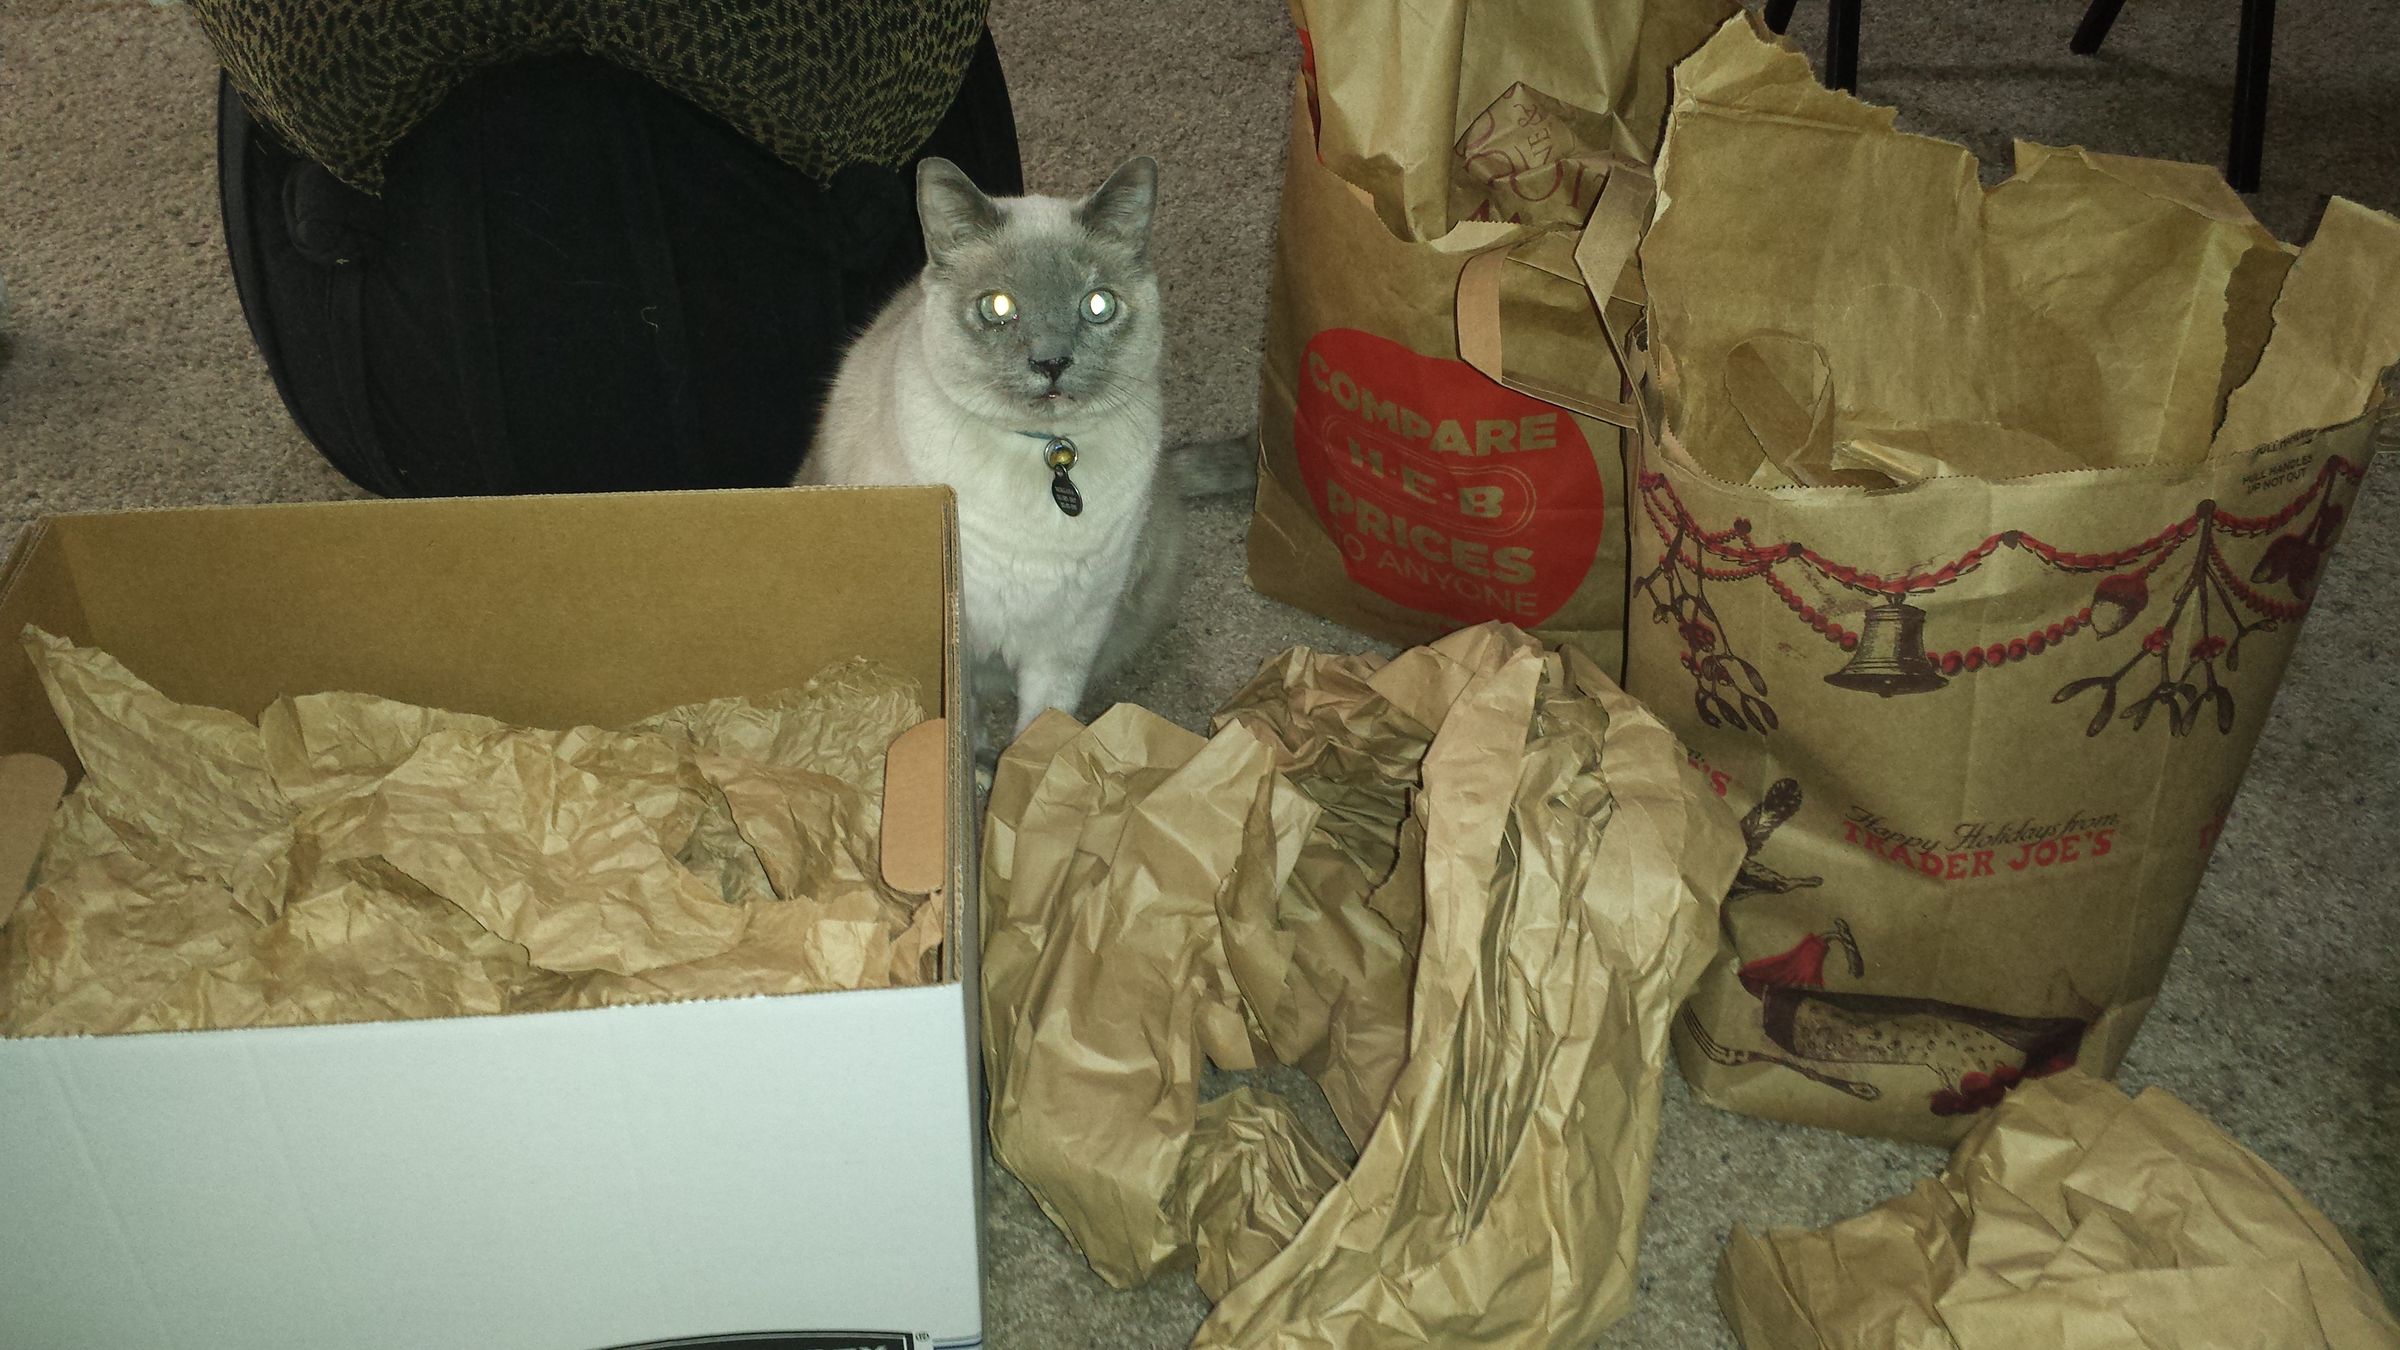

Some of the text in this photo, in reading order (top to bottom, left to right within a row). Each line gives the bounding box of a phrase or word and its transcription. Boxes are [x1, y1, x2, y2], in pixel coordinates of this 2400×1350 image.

[1308, 350, 1558, 458] COMPARE
[2263, 475, 2285, 490] NOT
[2286, 467, 2307, 483] OUT
[2269, 454, 2313, 476] HANDLES
[1327, 479, 1537, 585] PRICES
[1376, 549, 1539, 618] ANYONE
[1843, 820, 2117, 881] TRADER JOE'S
[1845, 805, 2119, 855] Happy Holidays from
